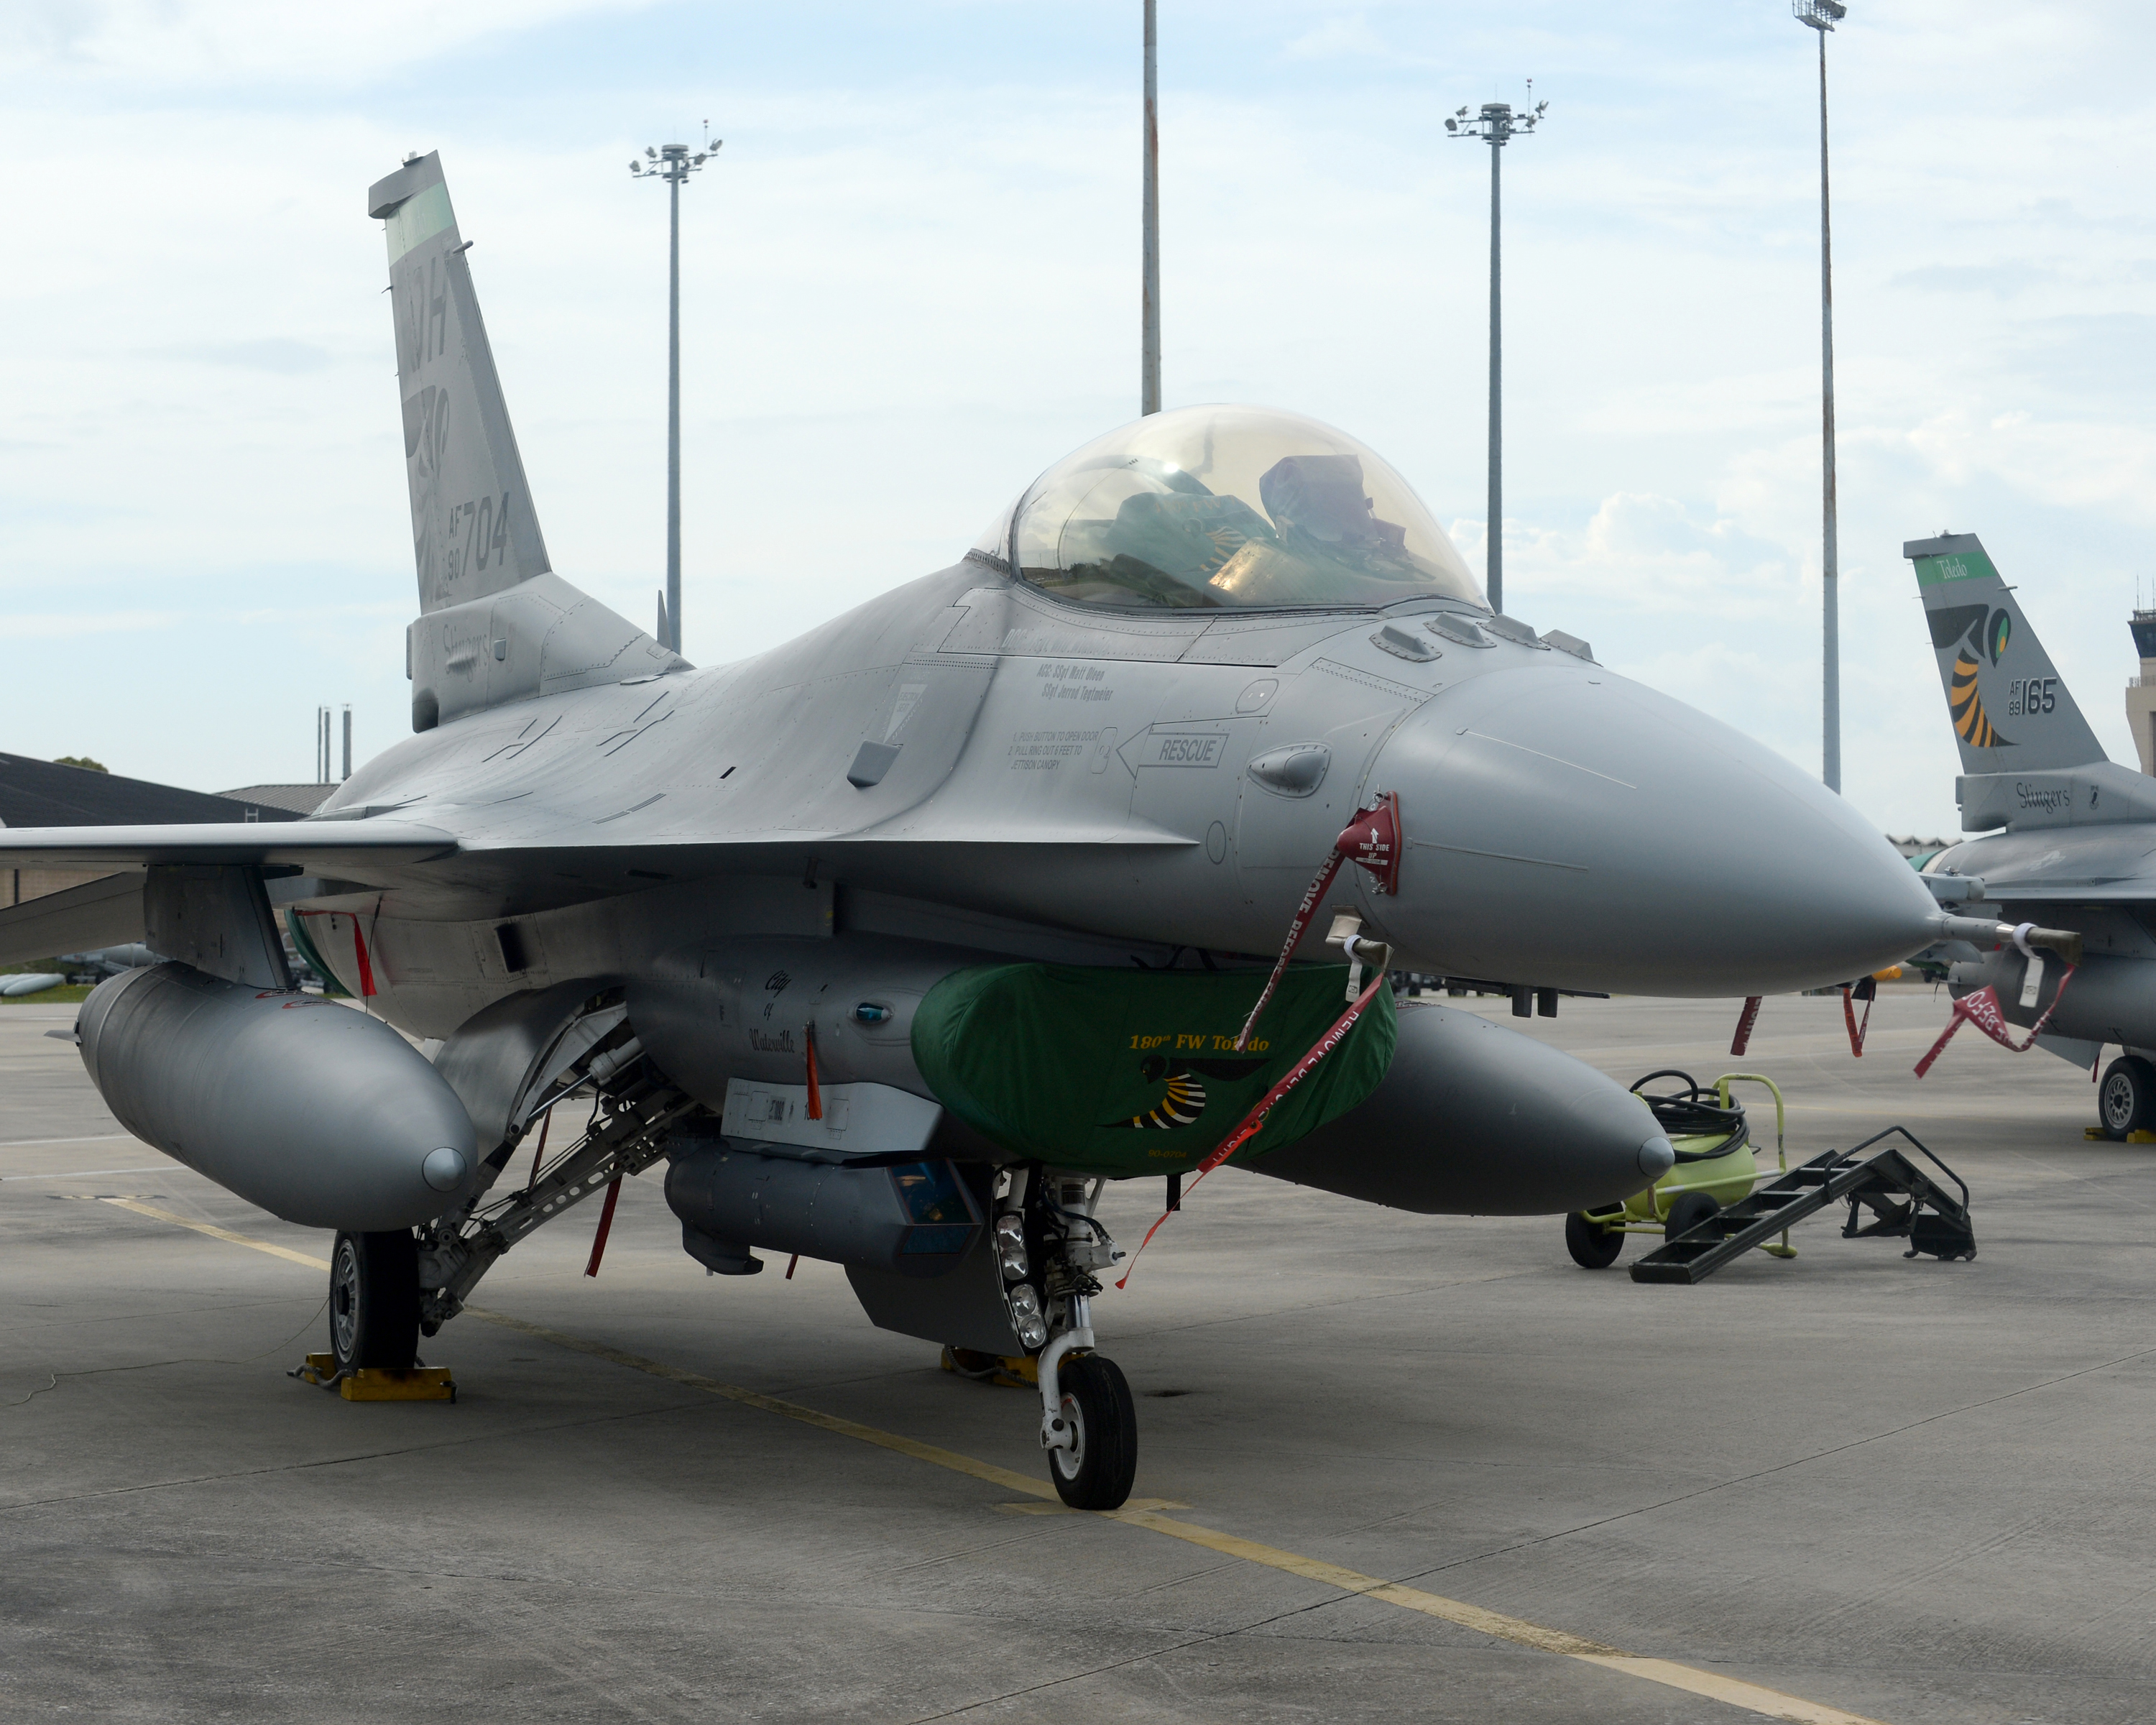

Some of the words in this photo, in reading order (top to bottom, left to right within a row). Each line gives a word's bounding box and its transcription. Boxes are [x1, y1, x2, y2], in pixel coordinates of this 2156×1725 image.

[448, 505, 462, 539] AF
[461, 491, 510, 576] 704
[448, 547, 461, 581] 90
[1937, 558, 1968, 579] Toledo
[1069, 665, 1087, 680] Matt
[2009, 679, 2021, 696] AF
[2021, 677, 2057, 714] 165
[2009, 700, 2021, 716] 89
[1019, 732, 1033, 742] PUSH
[1033, 731, 1056, 742] BUTTON
[1056, 731, 1065, 741] TO
[1065, 731, 1082, 741] OPEN
[1081, 731, 1099, 741] DOOR
[1014, 745, 1028, 755] PULL
[1028, 745, 1043, 755] RING
[1043, 745, 1055, 755] OUT
[1059, 745, 1075, 755] FEET
[1074, 745, 1083, 755] TO
[1158, 739, 1217, 762] RESCUE
[1010, 759, 1037, 770] JETTISON
[1037, 759, 1061, 770] CANOPY
[2017, 782, 2070, 814] Stingers
[1360, 842, 1373, 851] THIS
[765, 970, 792, 998] City
[749, 1028, 796, 1054] Waterville
[1129, 1034, 1172, 1050] 180th
[1175, 1034, 1207, 1049] FW
[1212, 1035, 1270, 1052] Toldo
[1148, 1149, 1187, 1159] 90-0704
